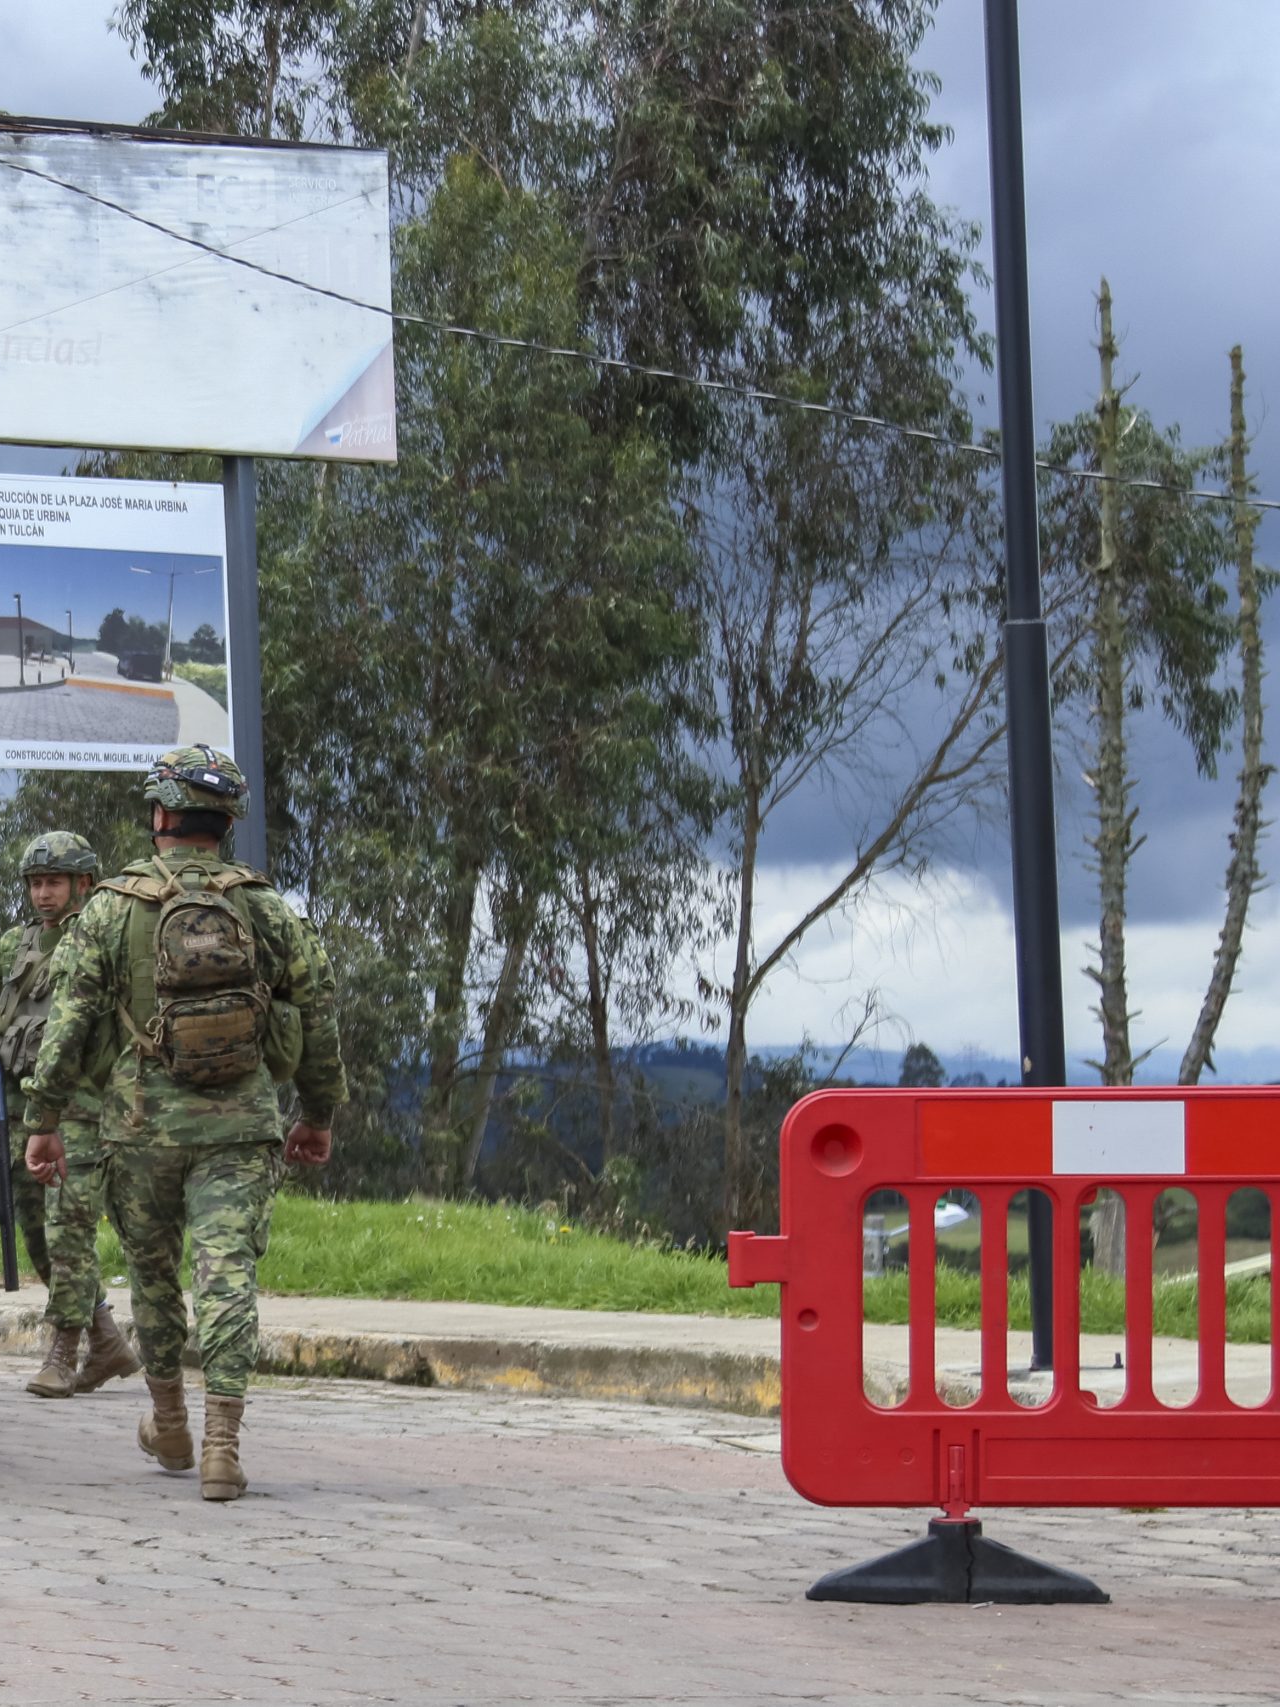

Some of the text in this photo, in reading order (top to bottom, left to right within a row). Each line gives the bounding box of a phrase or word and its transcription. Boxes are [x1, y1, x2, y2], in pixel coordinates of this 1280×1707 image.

[41, 494, 53, 505] DE
[55, 495, 67, 506] LA
[69, 495, 98, 508] PLAZA
[100, 495, 123, 509] JOSÉ
[125, 498, 153, 511] MARIA
[155, 500, 188, 513] URBINA
[23, 509, 35, 521] DE
[37, 510, 71, 522] URBINA
[9, 523, 45, 537] TULCÁN
[68, 752, 102, 763] ING.CIVIL
[104, 754, 131, 763] MIGUEL
[133, 753, 155, 764] MEJÍA
